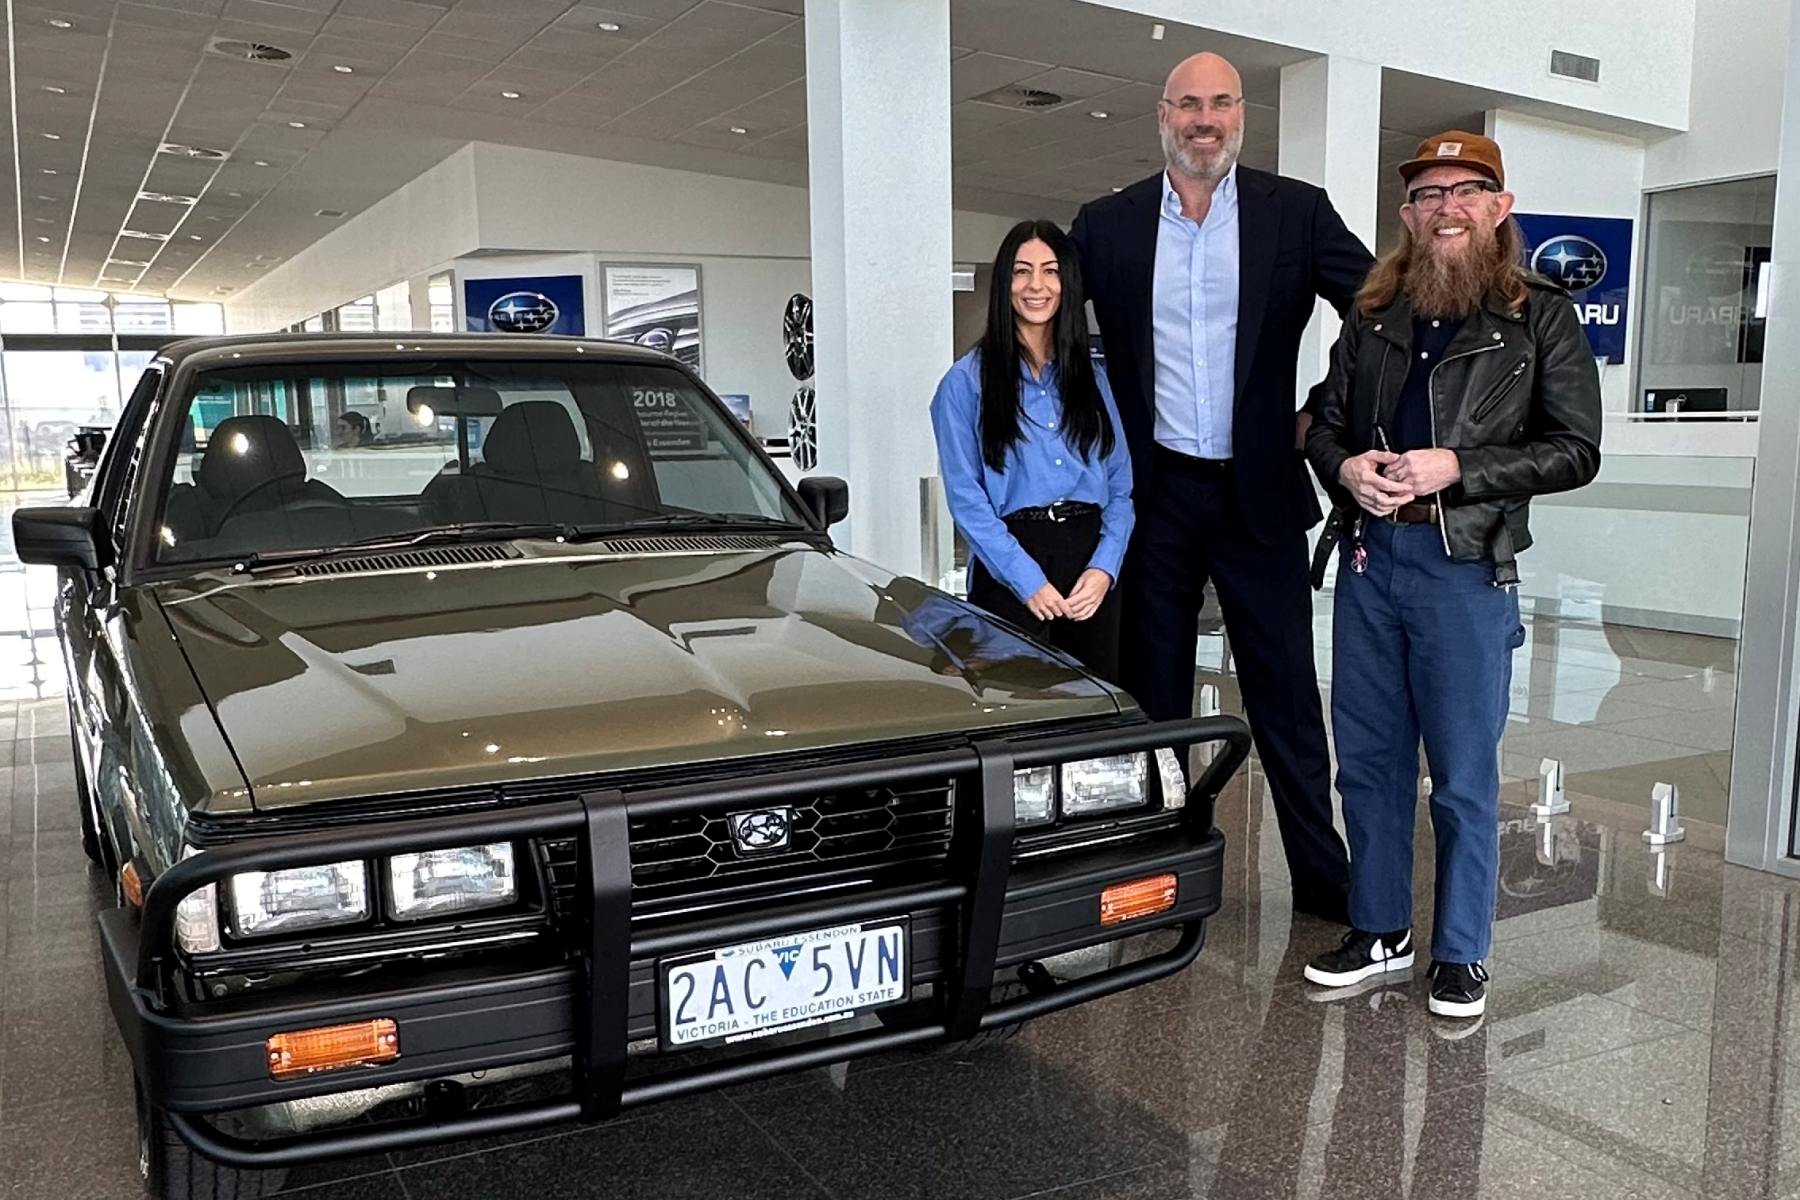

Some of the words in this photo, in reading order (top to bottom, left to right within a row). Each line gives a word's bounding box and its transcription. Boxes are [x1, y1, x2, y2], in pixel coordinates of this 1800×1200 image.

[633, 390, 676, 407] 2018
[794, 927, 858, 945] ESSENDON
[776, 950, 800, 964] VIC
[673, 959, 767, 1026] 2AC
[813, 933, 899, 997] 5VN
[677, 1020, 740, 1040] VICTORIA
[753, 1010, 778, 1026] THE
[782, 995, 854, 1019] EDUCATION
[858, 987, 895, 1004] STATE
